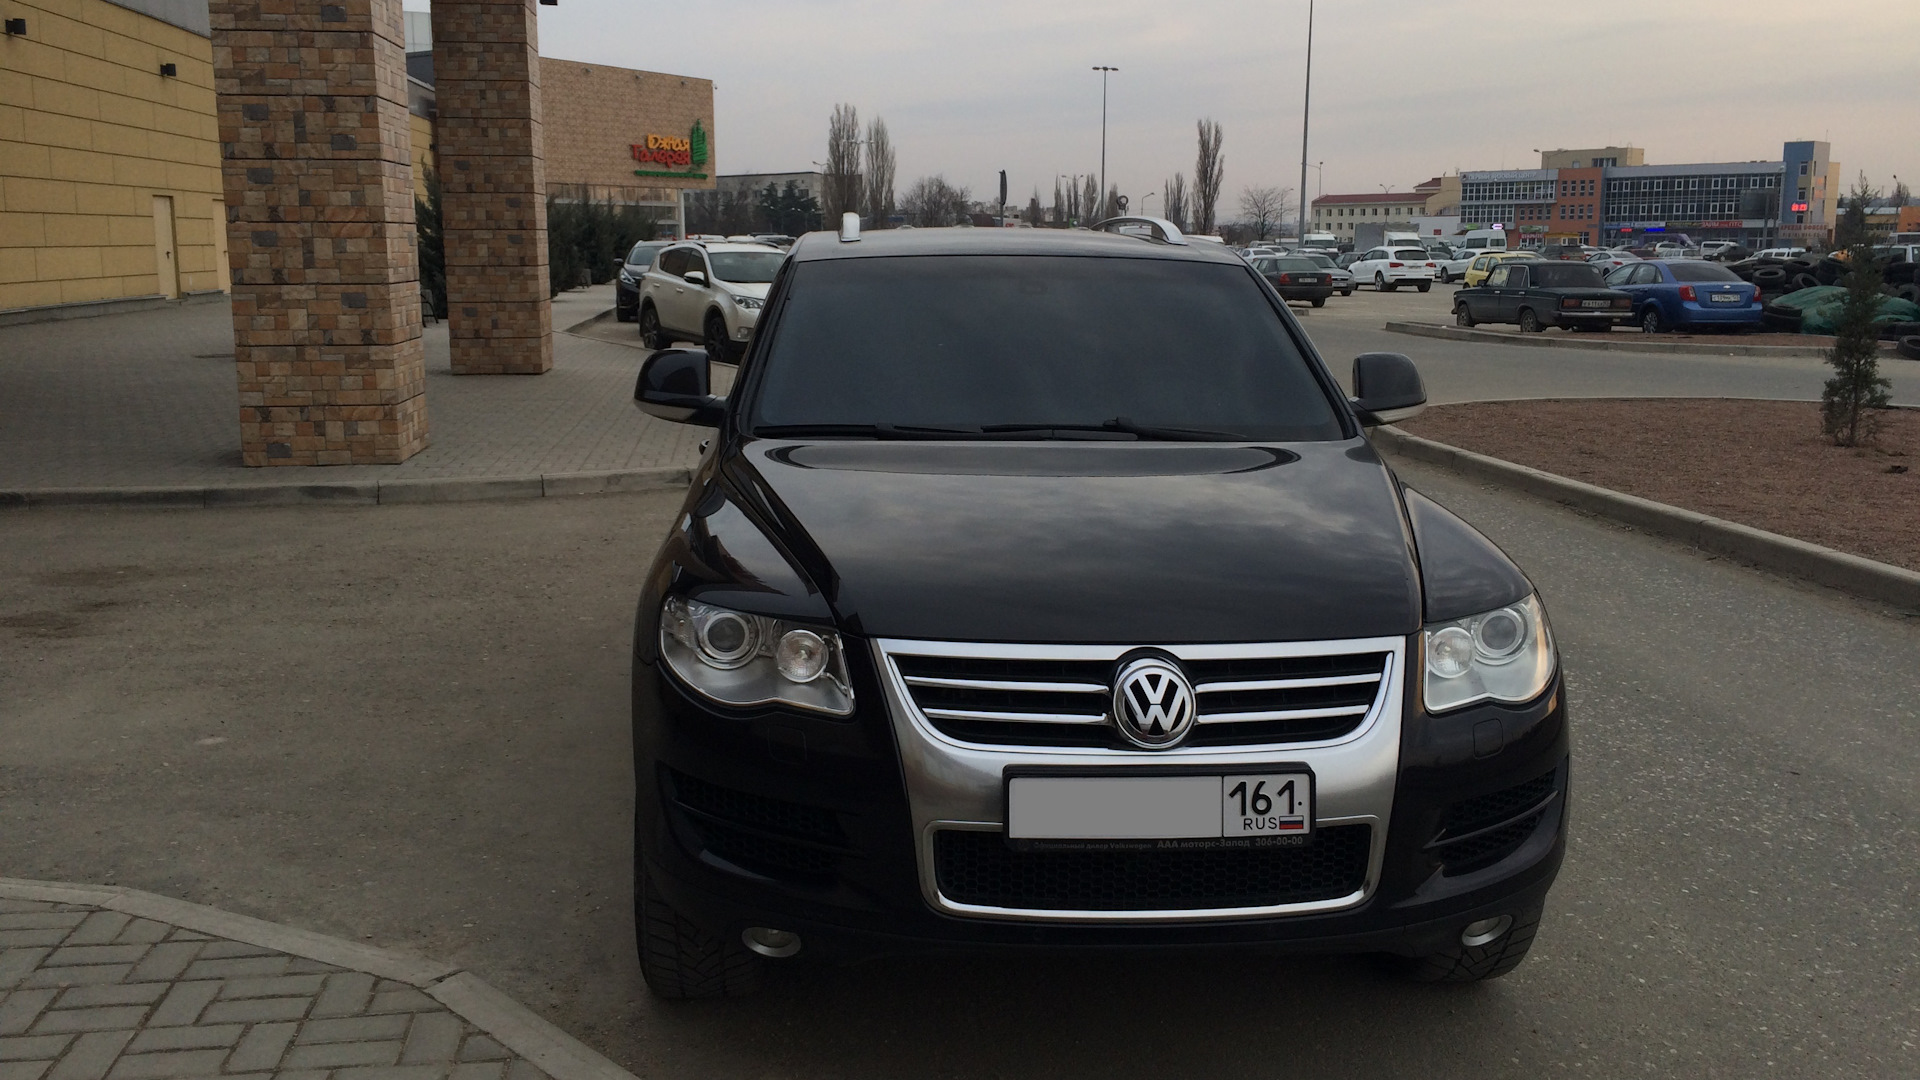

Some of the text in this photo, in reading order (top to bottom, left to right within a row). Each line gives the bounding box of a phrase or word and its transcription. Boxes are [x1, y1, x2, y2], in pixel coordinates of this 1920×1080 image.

[647, 133, 690, 151] Южная
[630, 144, 691, 168] Галерея
[1229, 780, 1295, 816] 161
[1243, 817, 1277, 831] RUS
